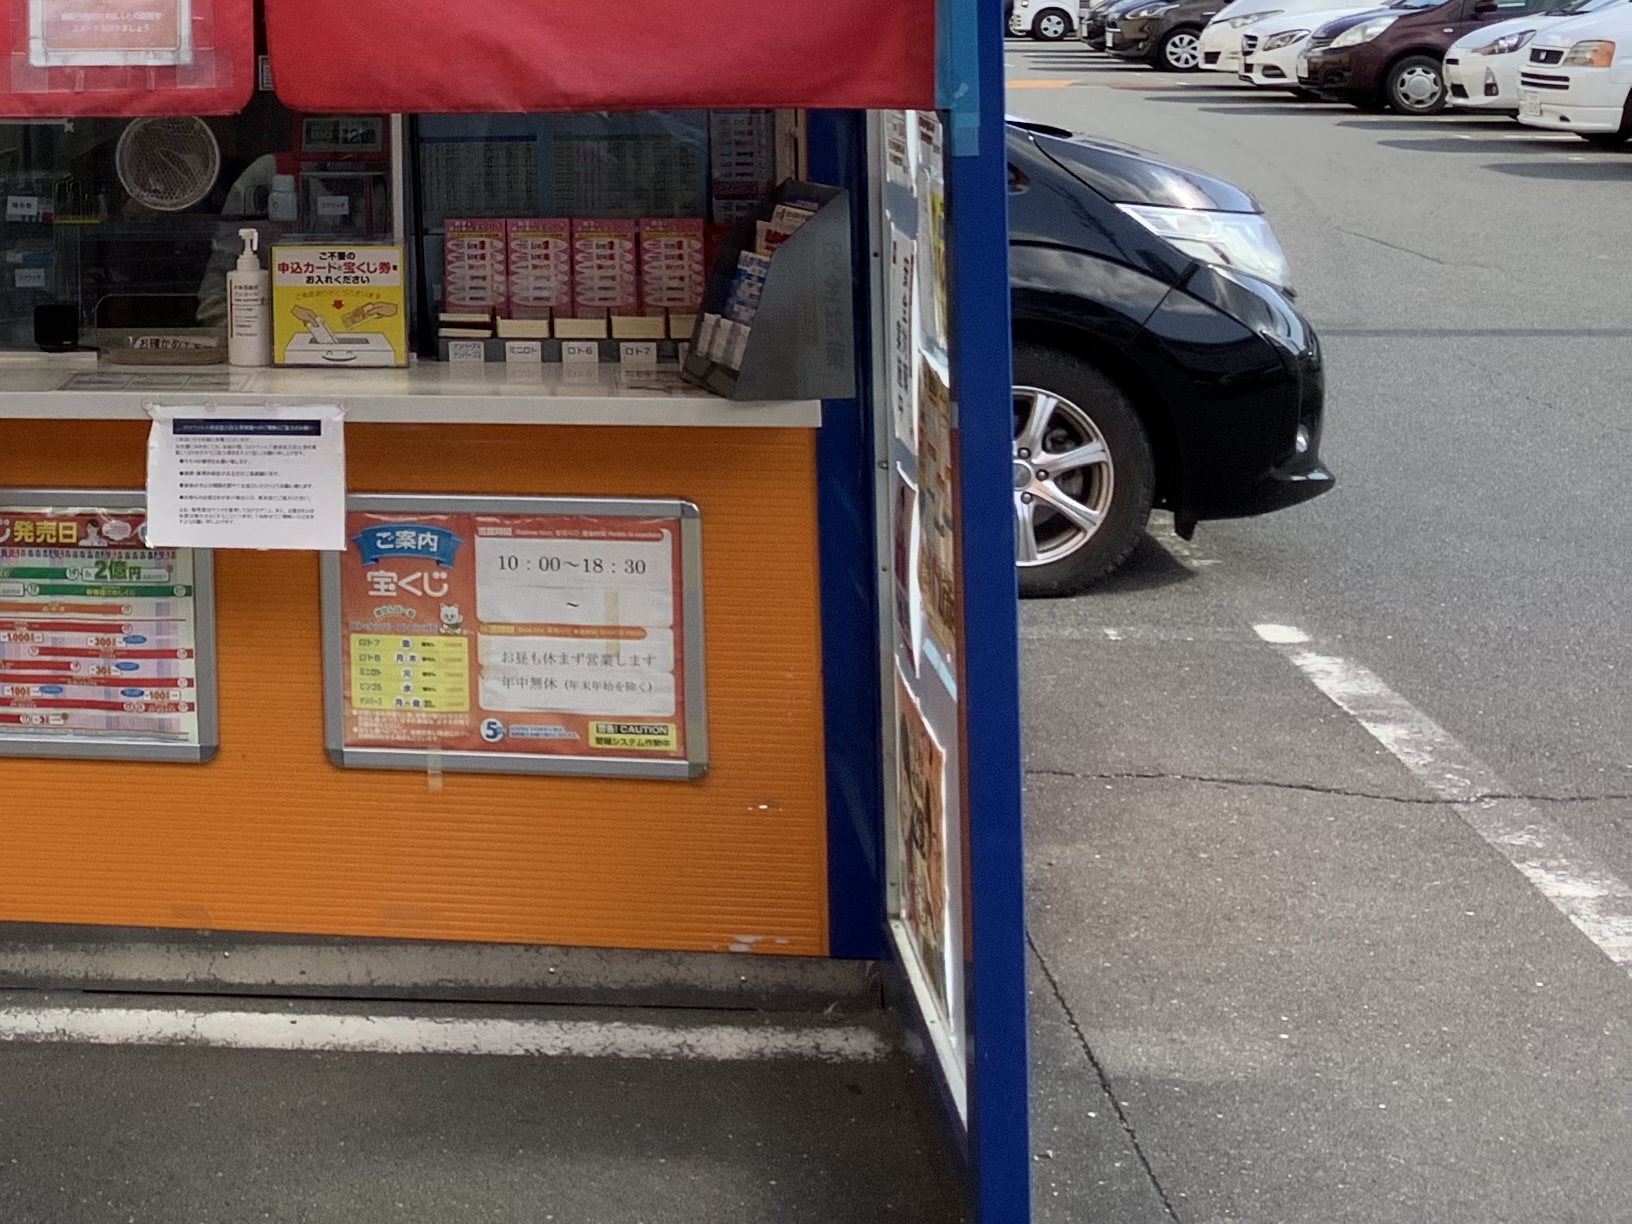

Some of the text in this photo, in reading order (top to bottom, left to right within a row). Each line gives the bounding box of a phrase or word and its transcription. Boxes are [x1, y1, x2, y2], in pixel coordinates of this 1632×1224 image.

[375, 528, 439, 554] ご案内
[366, 570, 449, 599] 宝くじ
[618, 724, 668, 736] CAUTION
